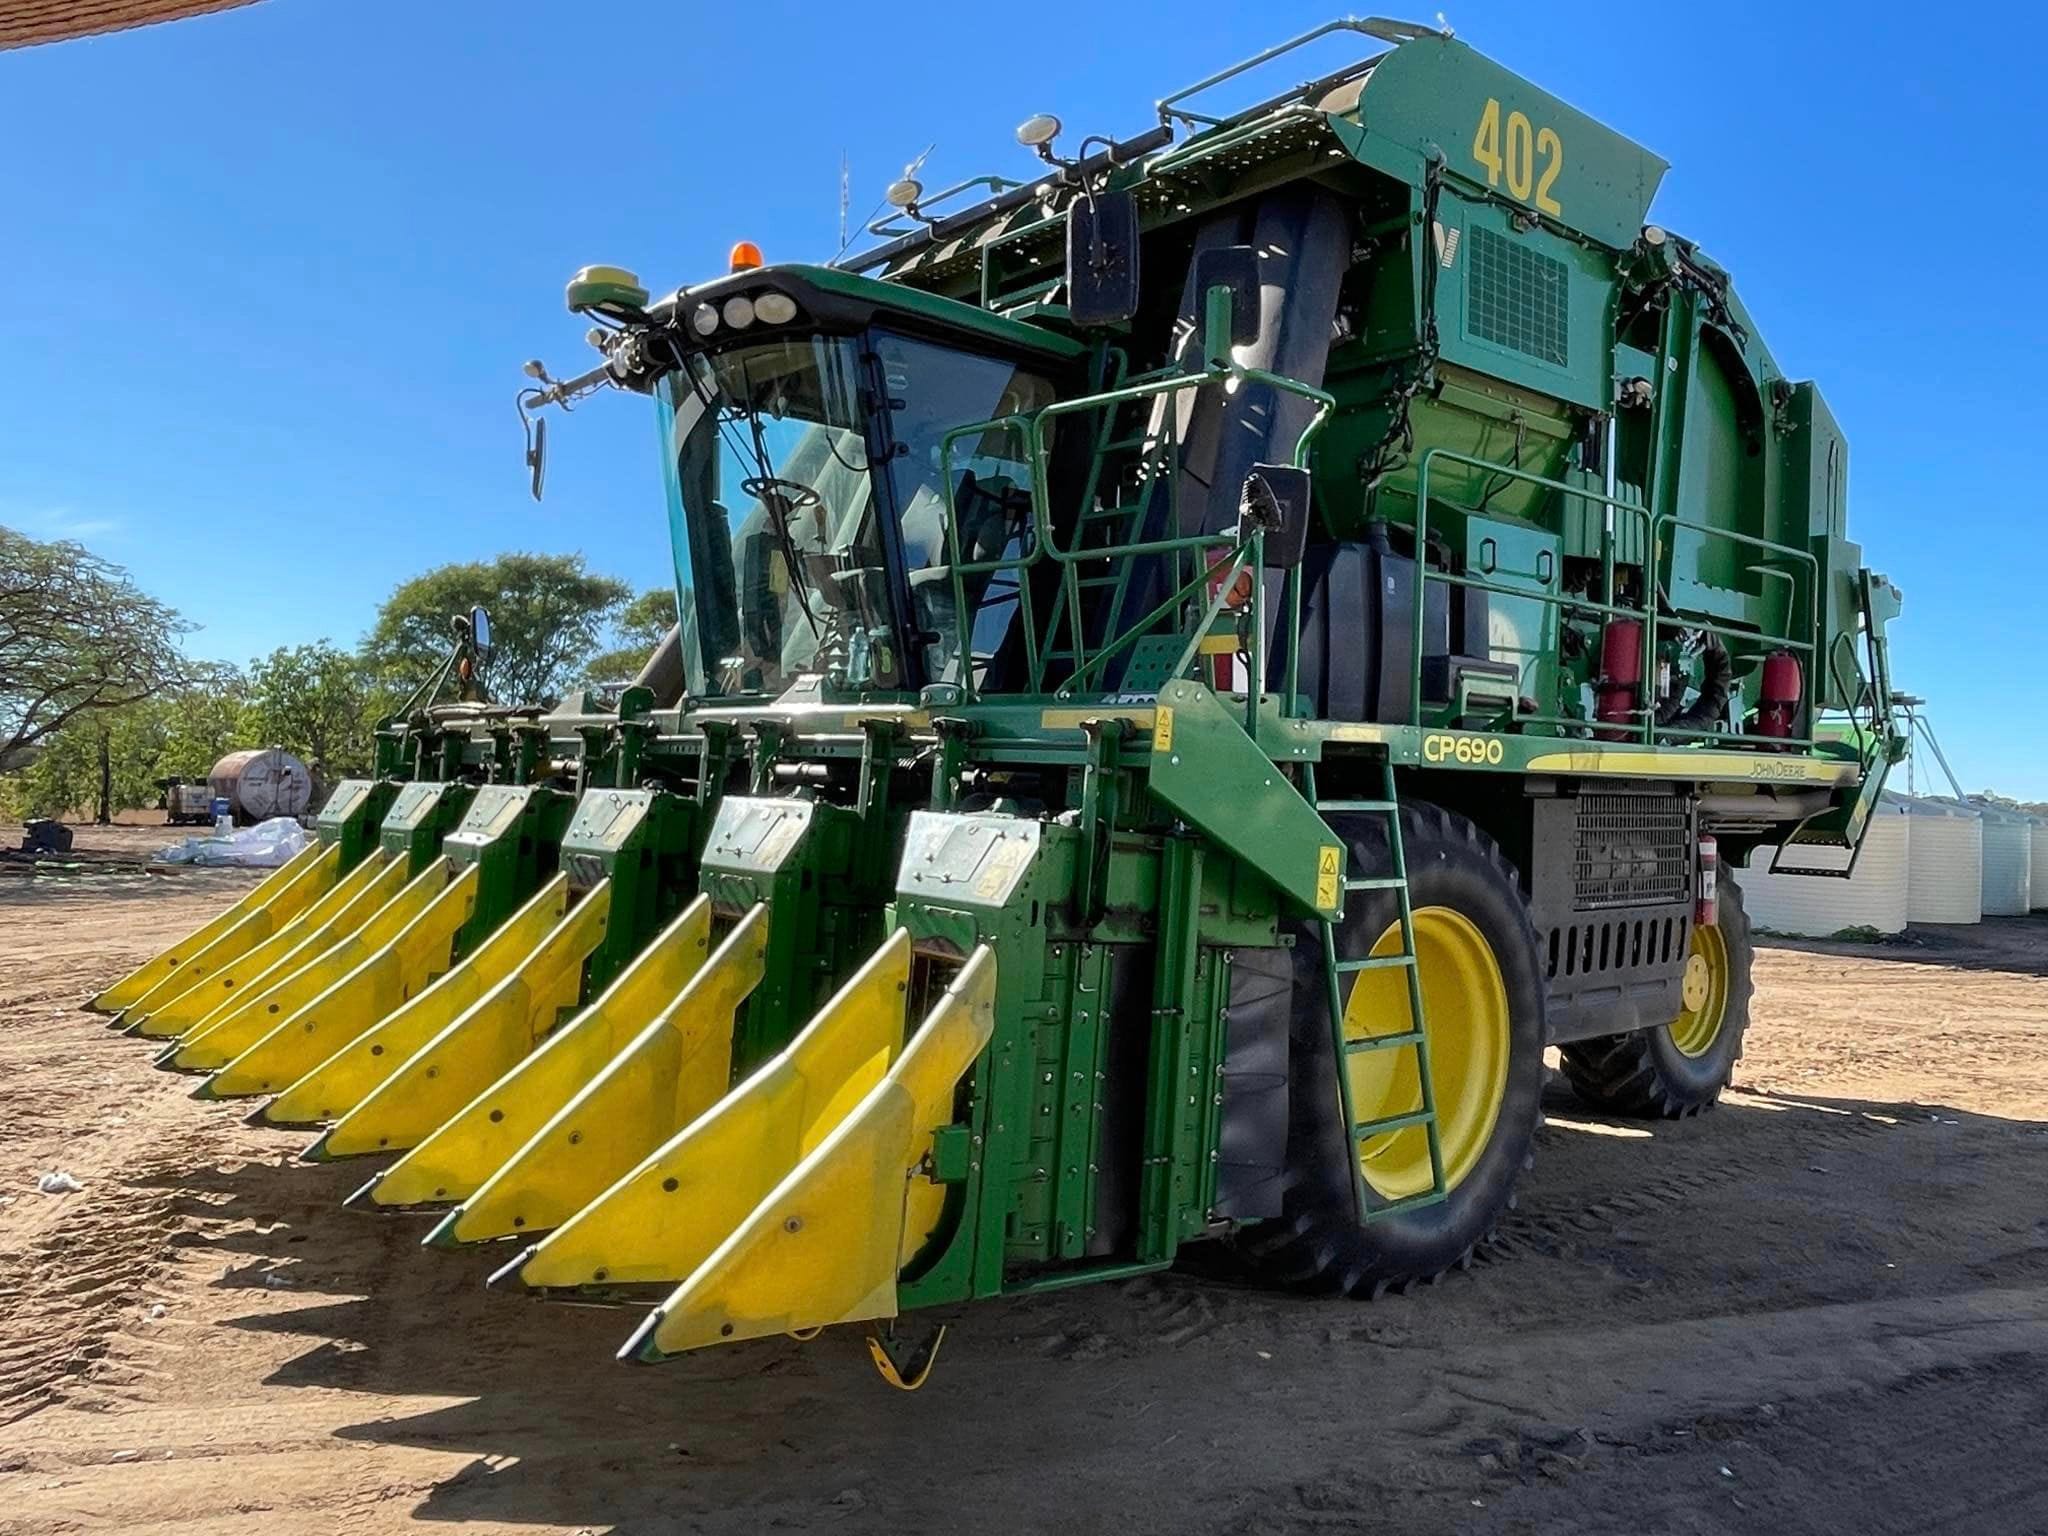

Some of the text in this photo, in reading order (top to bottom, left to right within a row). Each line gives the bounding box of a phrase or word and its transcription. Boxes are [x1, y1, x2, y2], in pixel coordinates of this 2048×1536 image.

[1473, 97, 1563, 217] 402
[1424, 734, 1504, 765] CP690
[1750, 760, 1806, 777] JOHN DEERE
